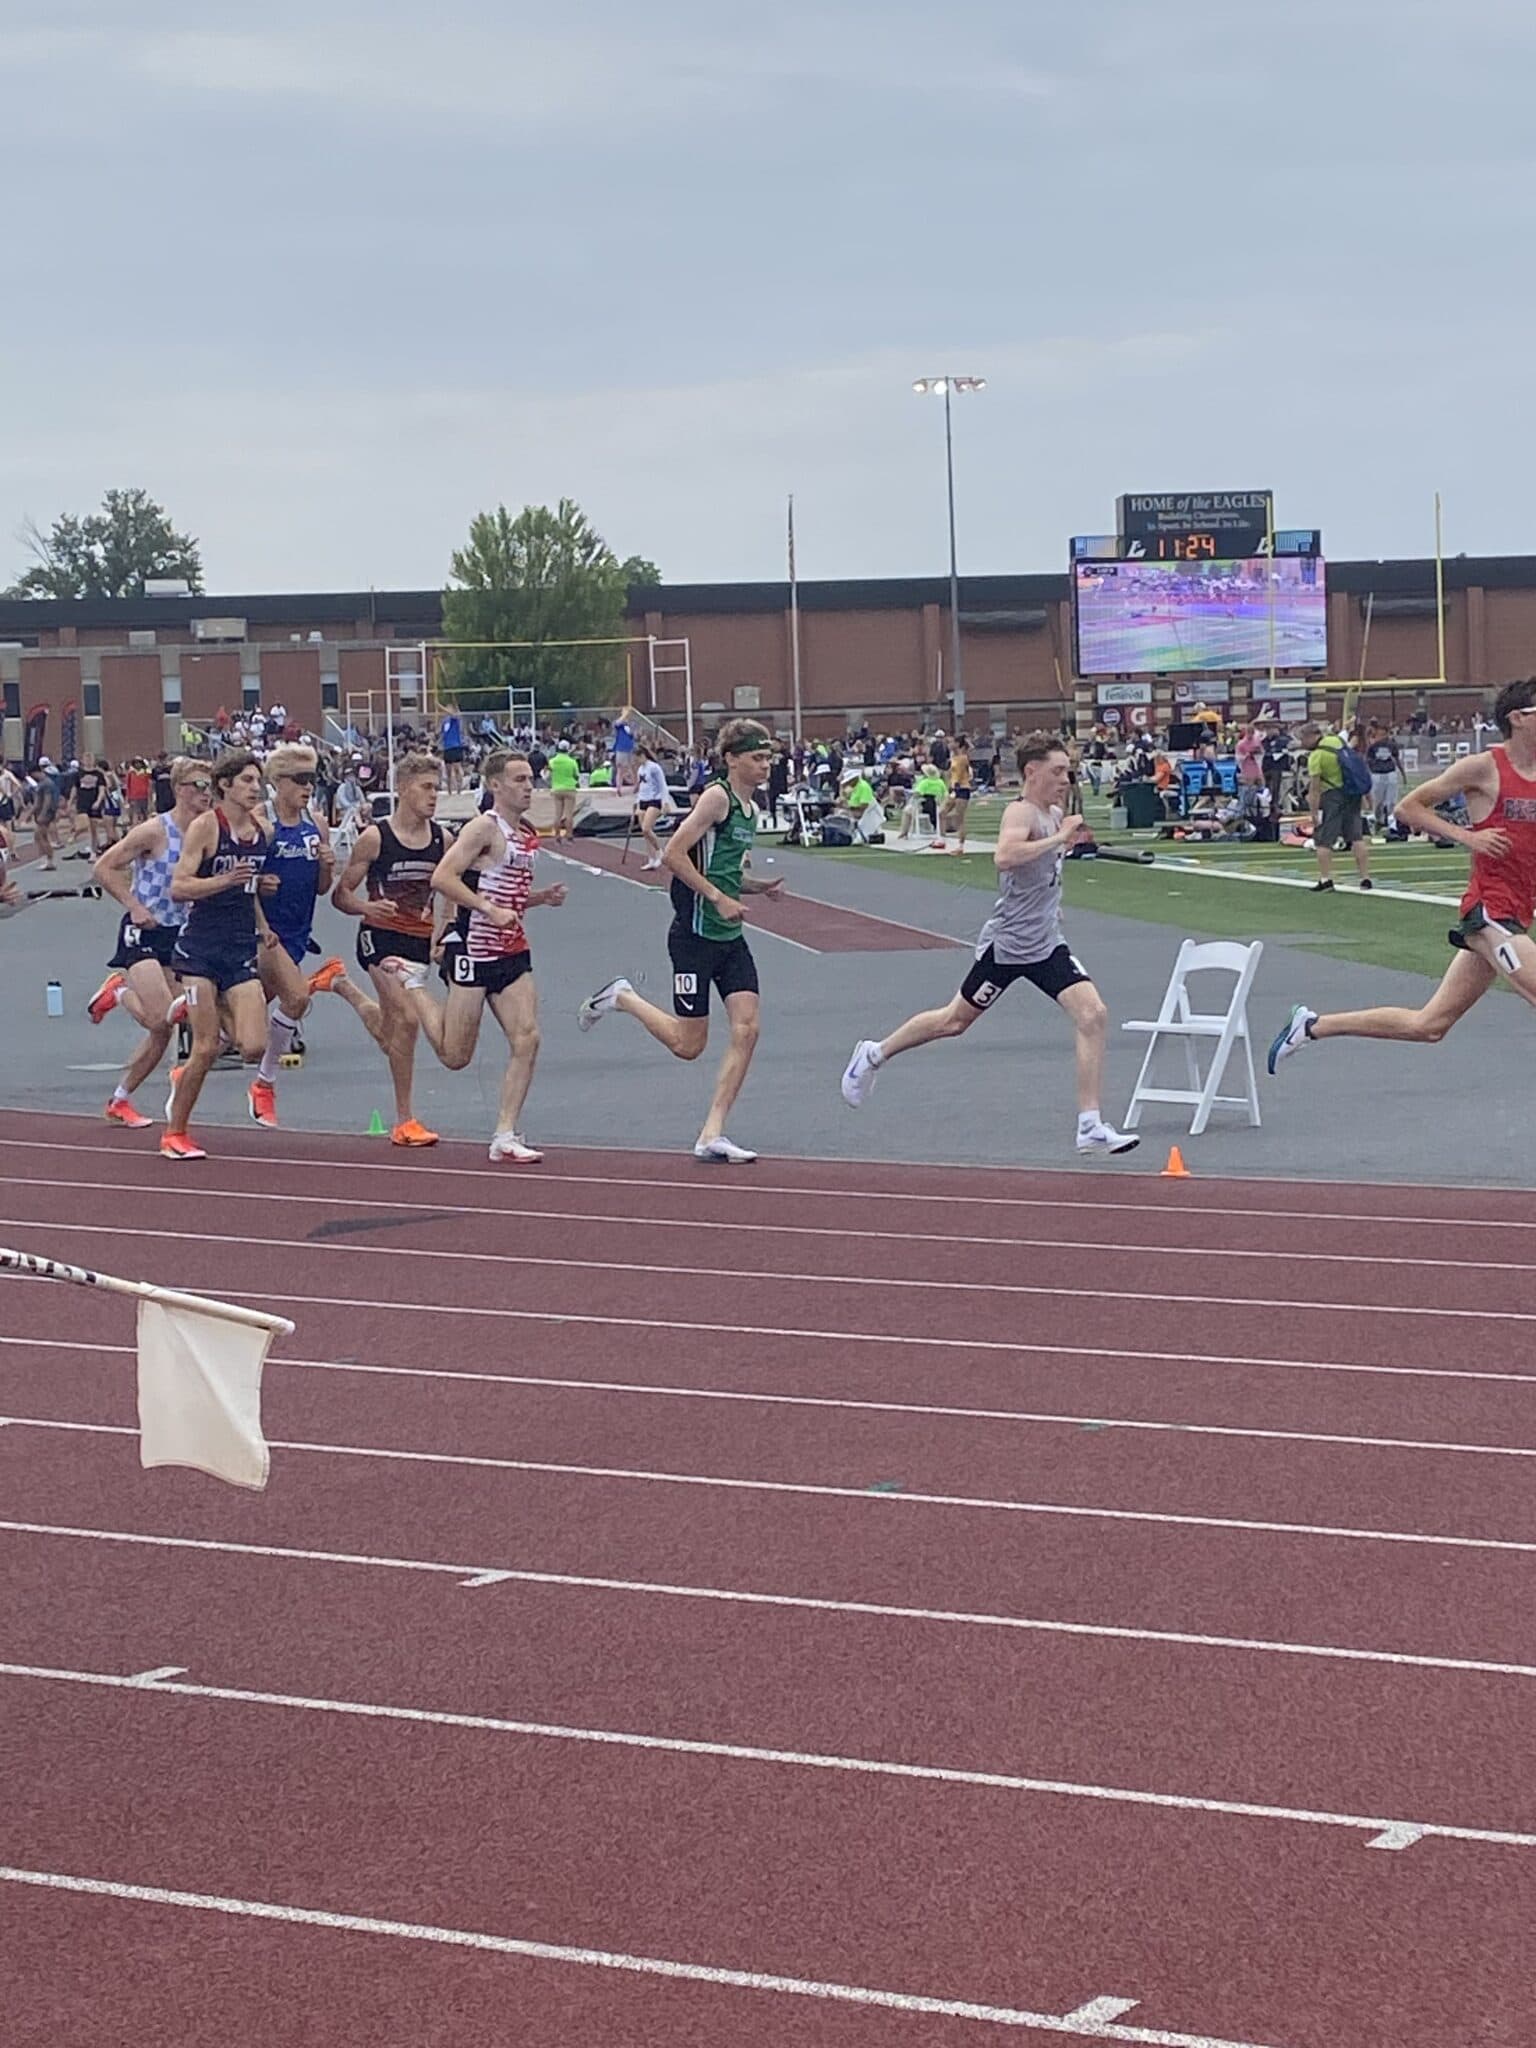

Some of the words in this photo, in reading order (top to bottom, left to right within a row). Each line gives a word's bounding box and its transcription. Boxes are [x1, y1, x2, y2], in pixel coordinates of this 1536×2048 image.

[1131, 498, 1174, 512] HOME
[1177, 496, 1189, 511] of
[1193, 495, 1210, 509] the
[1214, 494, 1266, 509] EAGLES
[1159, 534, 1215, 558] 11:24
[1131, 707, 1147, 726] G
[309, 836, 320, 858] 6
[1500, 946, 1514, 970] 1
[459, 957, 470, 980] 9
[677, 975, 693, 993] 10
[977, 985, 996, 1004] 3
